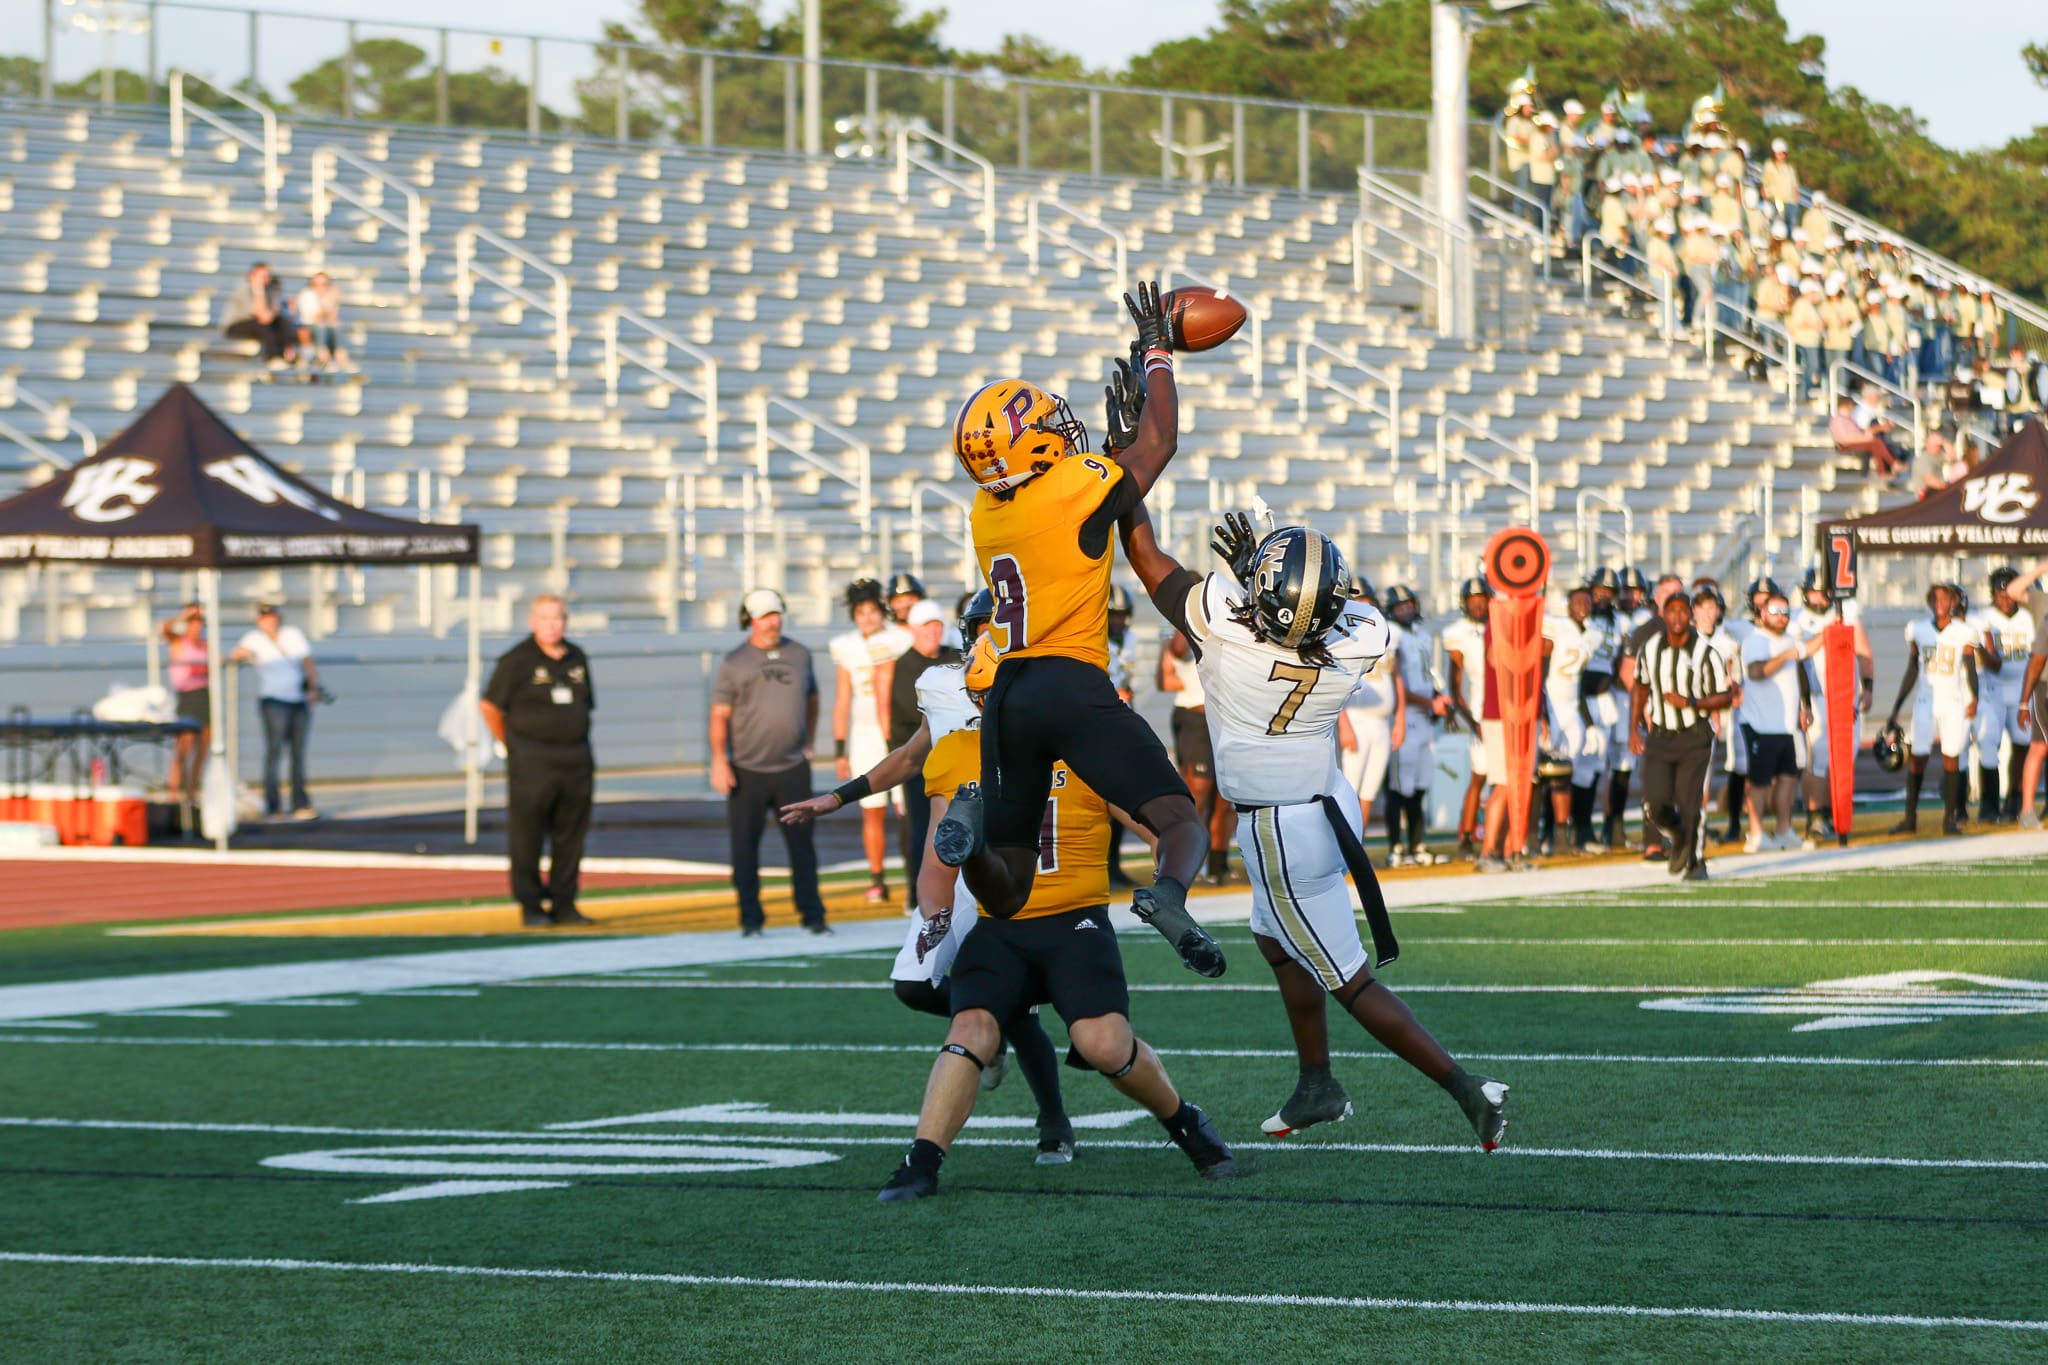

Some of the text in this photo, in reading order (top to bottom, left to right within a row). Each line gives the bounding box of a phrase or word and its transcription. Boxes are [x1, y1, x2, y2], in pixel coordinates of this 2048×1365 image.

[1001, 387, 1034, 449] P
[63, 456, 160, 523] WC
[1083, 457, 1109, 483] 9
[1964, 472, 2038, 523] WC
[1891, 526, 1953, 544] COUNTY
[1955, 525, 2020, 544] YELLOW
[1832, 535, 1855, 588] 2
[989, 553, 1029, 655] 9
[1312, 618, 1320, 631] 7
[1266, 661, 1321, 736] 7
